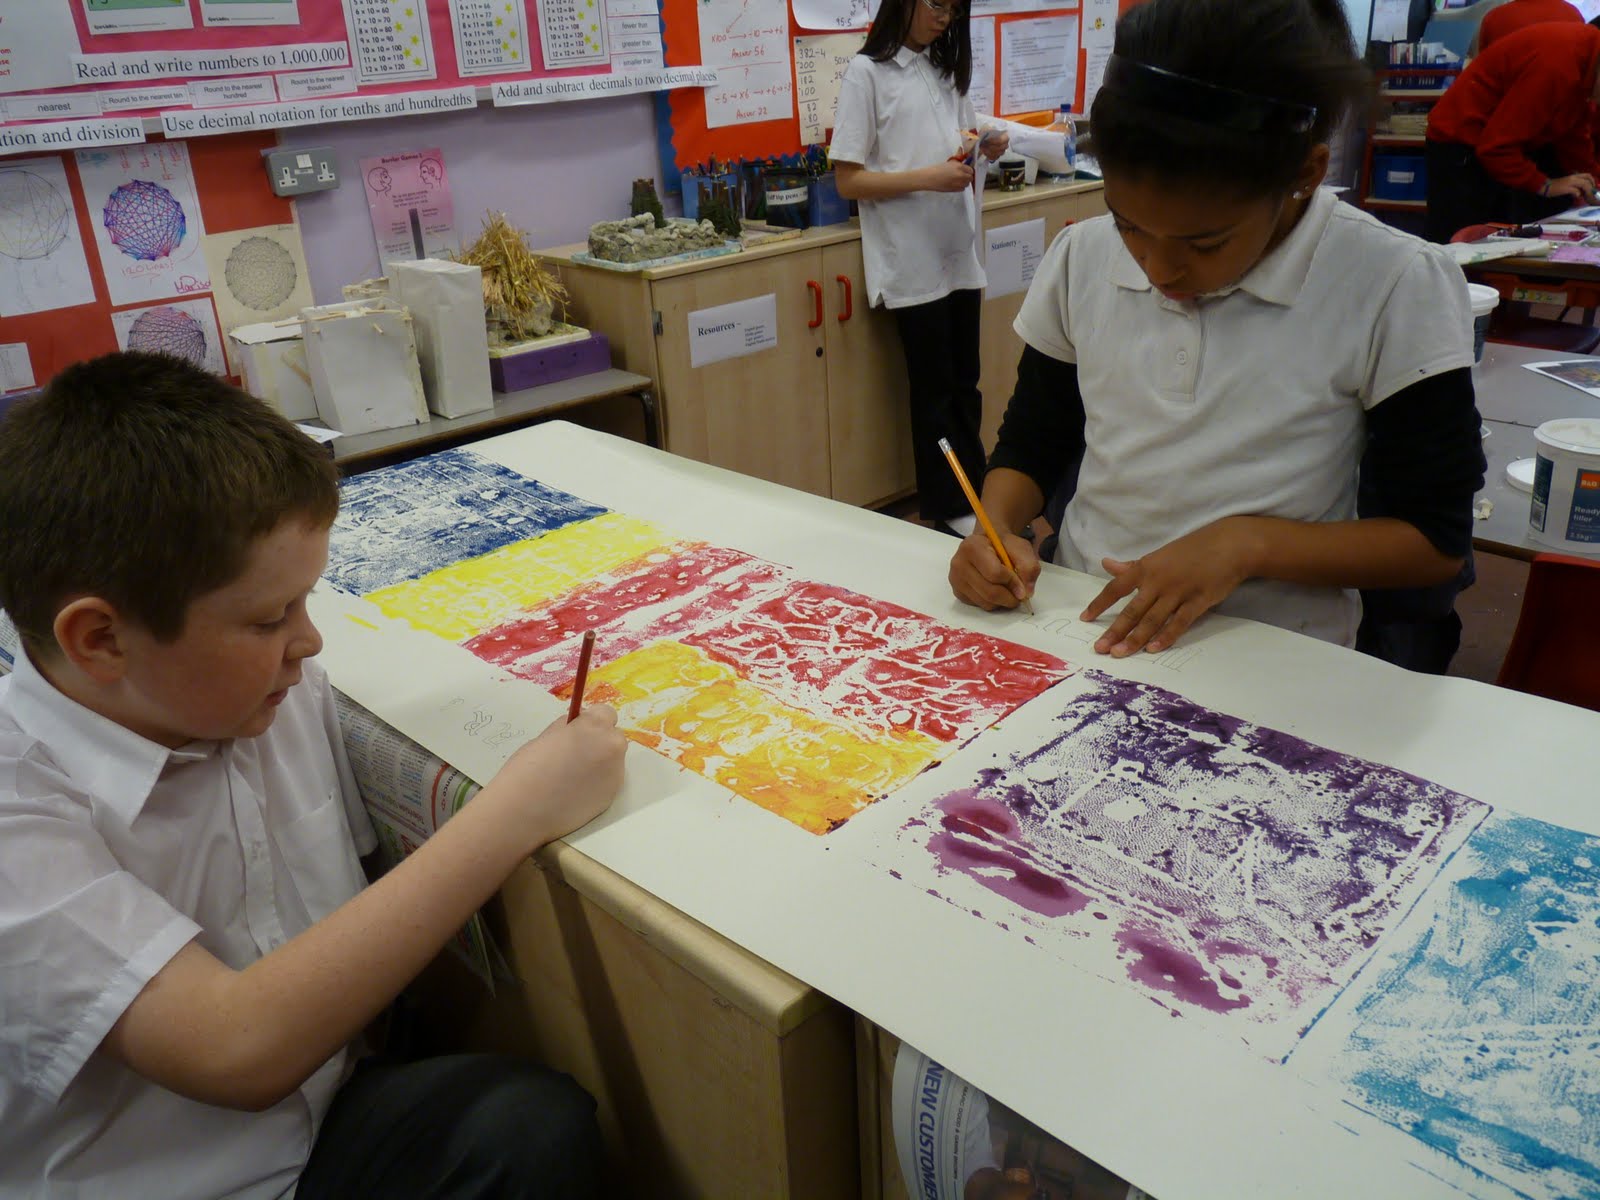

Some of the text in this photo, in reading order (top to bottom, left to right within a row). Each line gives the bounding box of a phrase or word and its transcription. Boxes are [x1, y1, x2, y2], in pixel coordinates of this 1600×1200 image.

[732, 46, 765, 58] Answer 56
[76, 47, 345, 78] Read and write numbers to 1,000,000
[242, 83, 263, 91] nearest
[497, 71, 718, 98] Add and subtract decimals to two decimal places
[38, 103, 71, 112] nearest
[165, 94, 472, 132] Use decimal notation for tenths and hundredths
[736, 107, 767, 119] Answer 22
[42, 127, 72, 143] and
[77, 124, 141, 141] division
[698, 322, 735, 337] Resources
[921, 1060, 945, 1111] NEW
[959, 1086, 969, 1107] MARC
